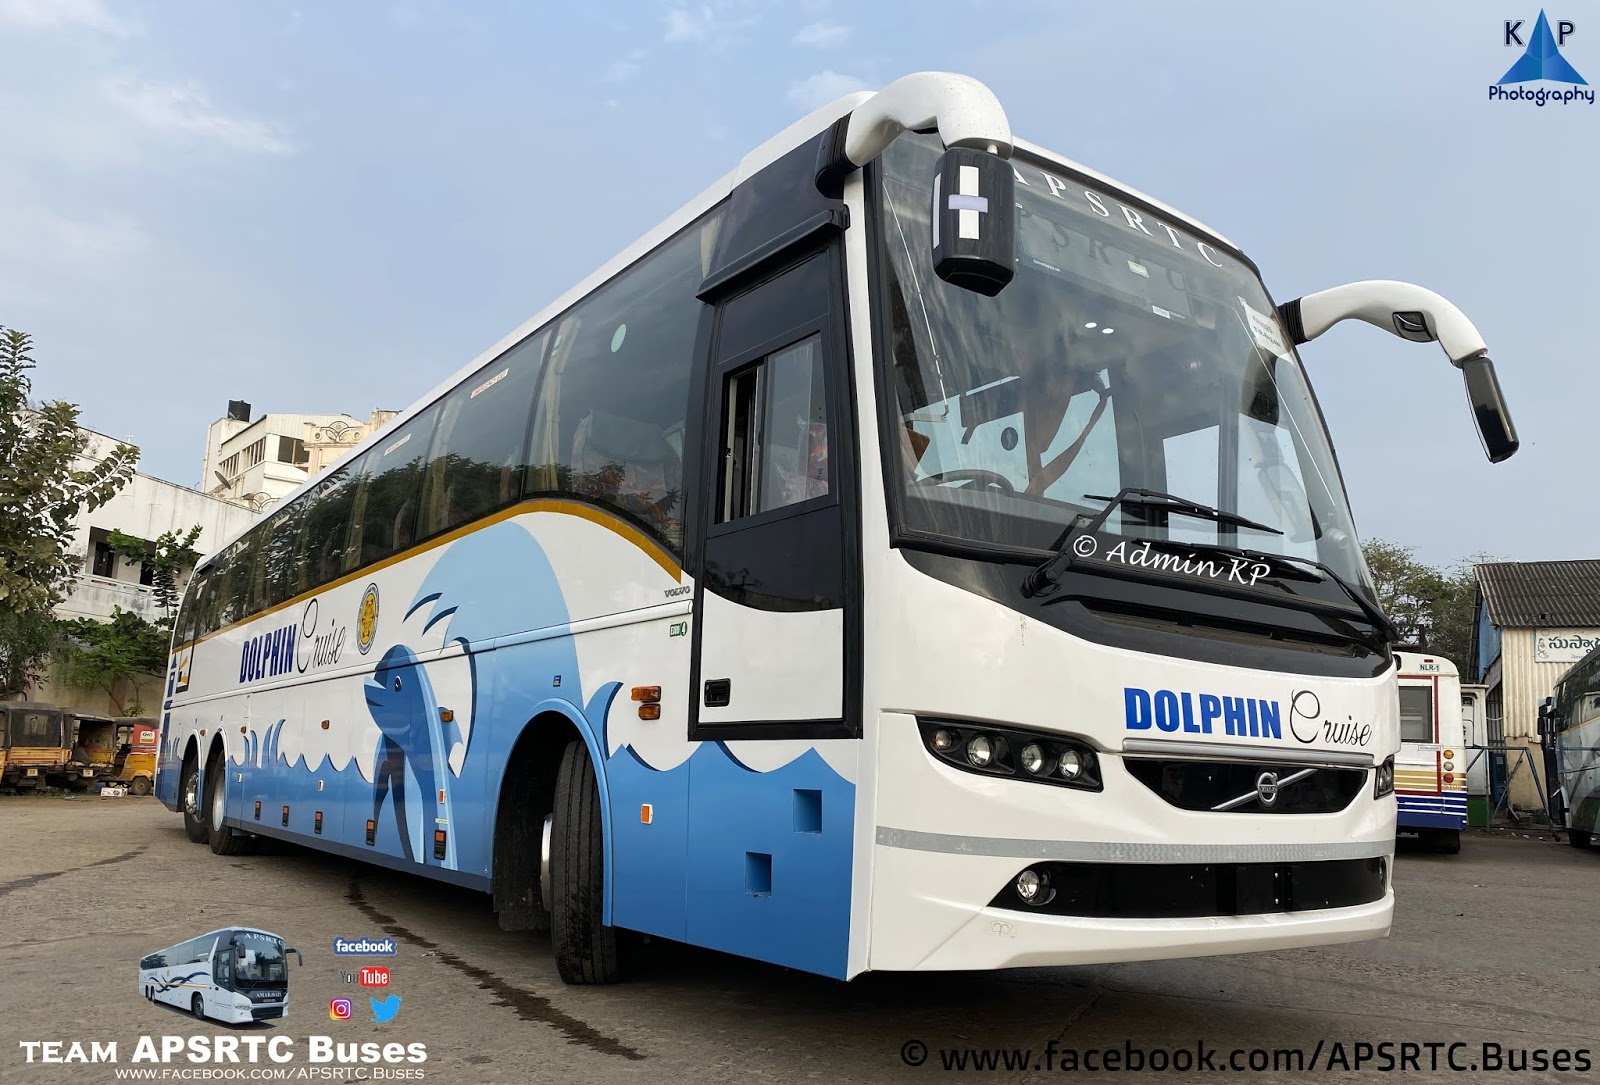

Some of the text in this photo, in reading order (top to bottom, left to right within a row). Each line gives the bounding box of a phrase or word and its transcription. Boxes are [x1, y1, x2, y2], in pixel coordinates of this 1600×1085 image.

[664, 585, 691, 598] VOLVO
[239, 623, 298, 684] DOLPHIN
[297, 598, 346, 674] Cruise
[1548, 635, 1600, 654] సుస్వా
[1124, 687, 1373, 747] DOLPHIN Cruise
